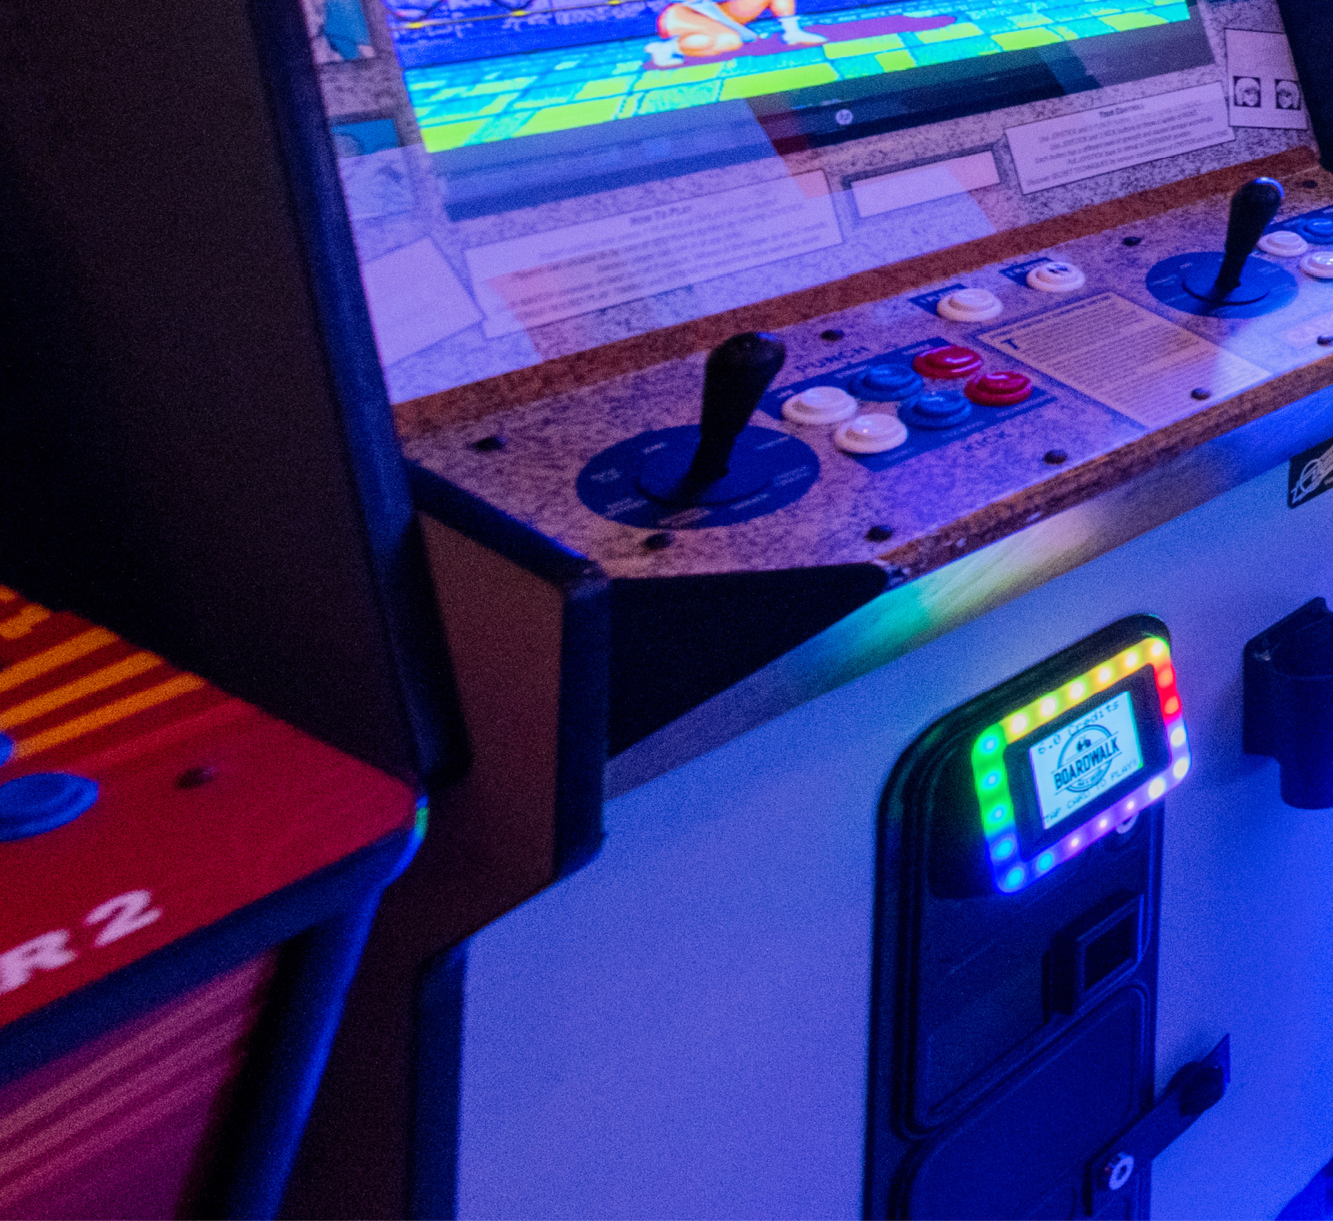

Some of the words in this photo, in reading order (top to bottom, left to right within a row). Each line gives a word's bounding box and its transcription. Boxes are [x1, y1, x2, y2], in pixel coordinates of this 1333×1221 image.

[1067, 700, 1120, 736] Credits
[1053, 737, 1121, 790] BOARDWALK
[84, 889, 163, 949] 2
